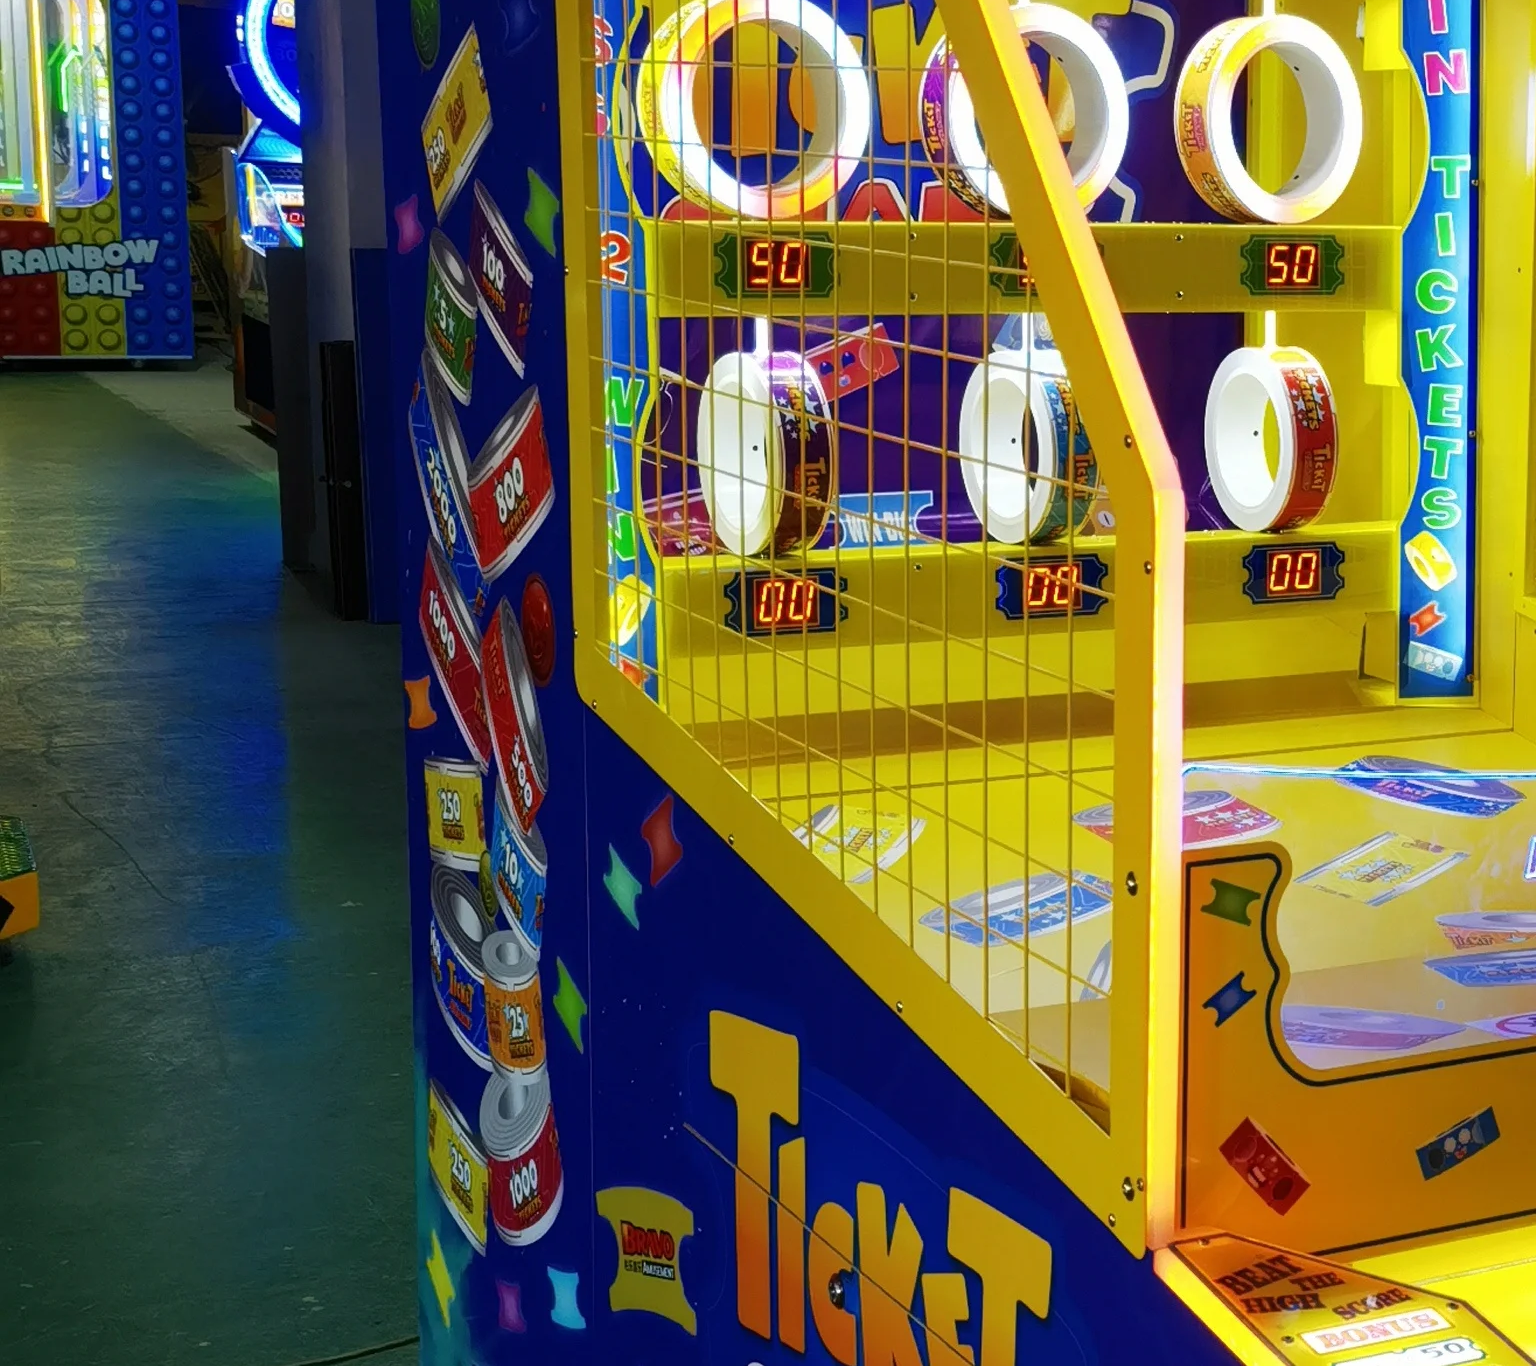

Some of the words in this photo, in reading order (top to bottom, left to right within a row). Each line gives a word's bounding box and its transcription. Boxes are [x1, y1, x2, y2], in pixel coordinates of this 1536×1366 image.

[2, 239, 160, 277] RAINBOW
[600, 230, 631, 285] 2
[750, 242, 807, 284] 50
[1268, 245, 1316, 284] 50
[67, 268, 144, 298] BALL
[1414, 154, 1471, 530] TICKETS
[1311, 442, 1331, 492] TICKET
[496, 456, 524, 523] 800
[1026, 565, 1080, 607] 00
[1269, 552, 1318, 593] 00
[758, 580, 815, 623] 00
[428, 589, 456, 660] 1000
[511, 742, 533, 808] 500
[441, 789, 462, 822] 250
[505, 843, 519, 885] 10
[510, 1006, 524, 1038] 25
[451, 1146, 472, 1191] 250
[510, 1158, 539, 1209] 1000
[620, 1219, 676, 1262] BRAVO
[1213, 1255, 1304, 1297] BEAT
[1292, 1269, 1345, 1290] THE
[1243, 1291, 1323, 1316] HIGH
[1333, 1288, 1412, 1320] SCORE
[1315, 1311, 1448, 1351] BONUS
[1421, 1342, 1466, 1361] 50
